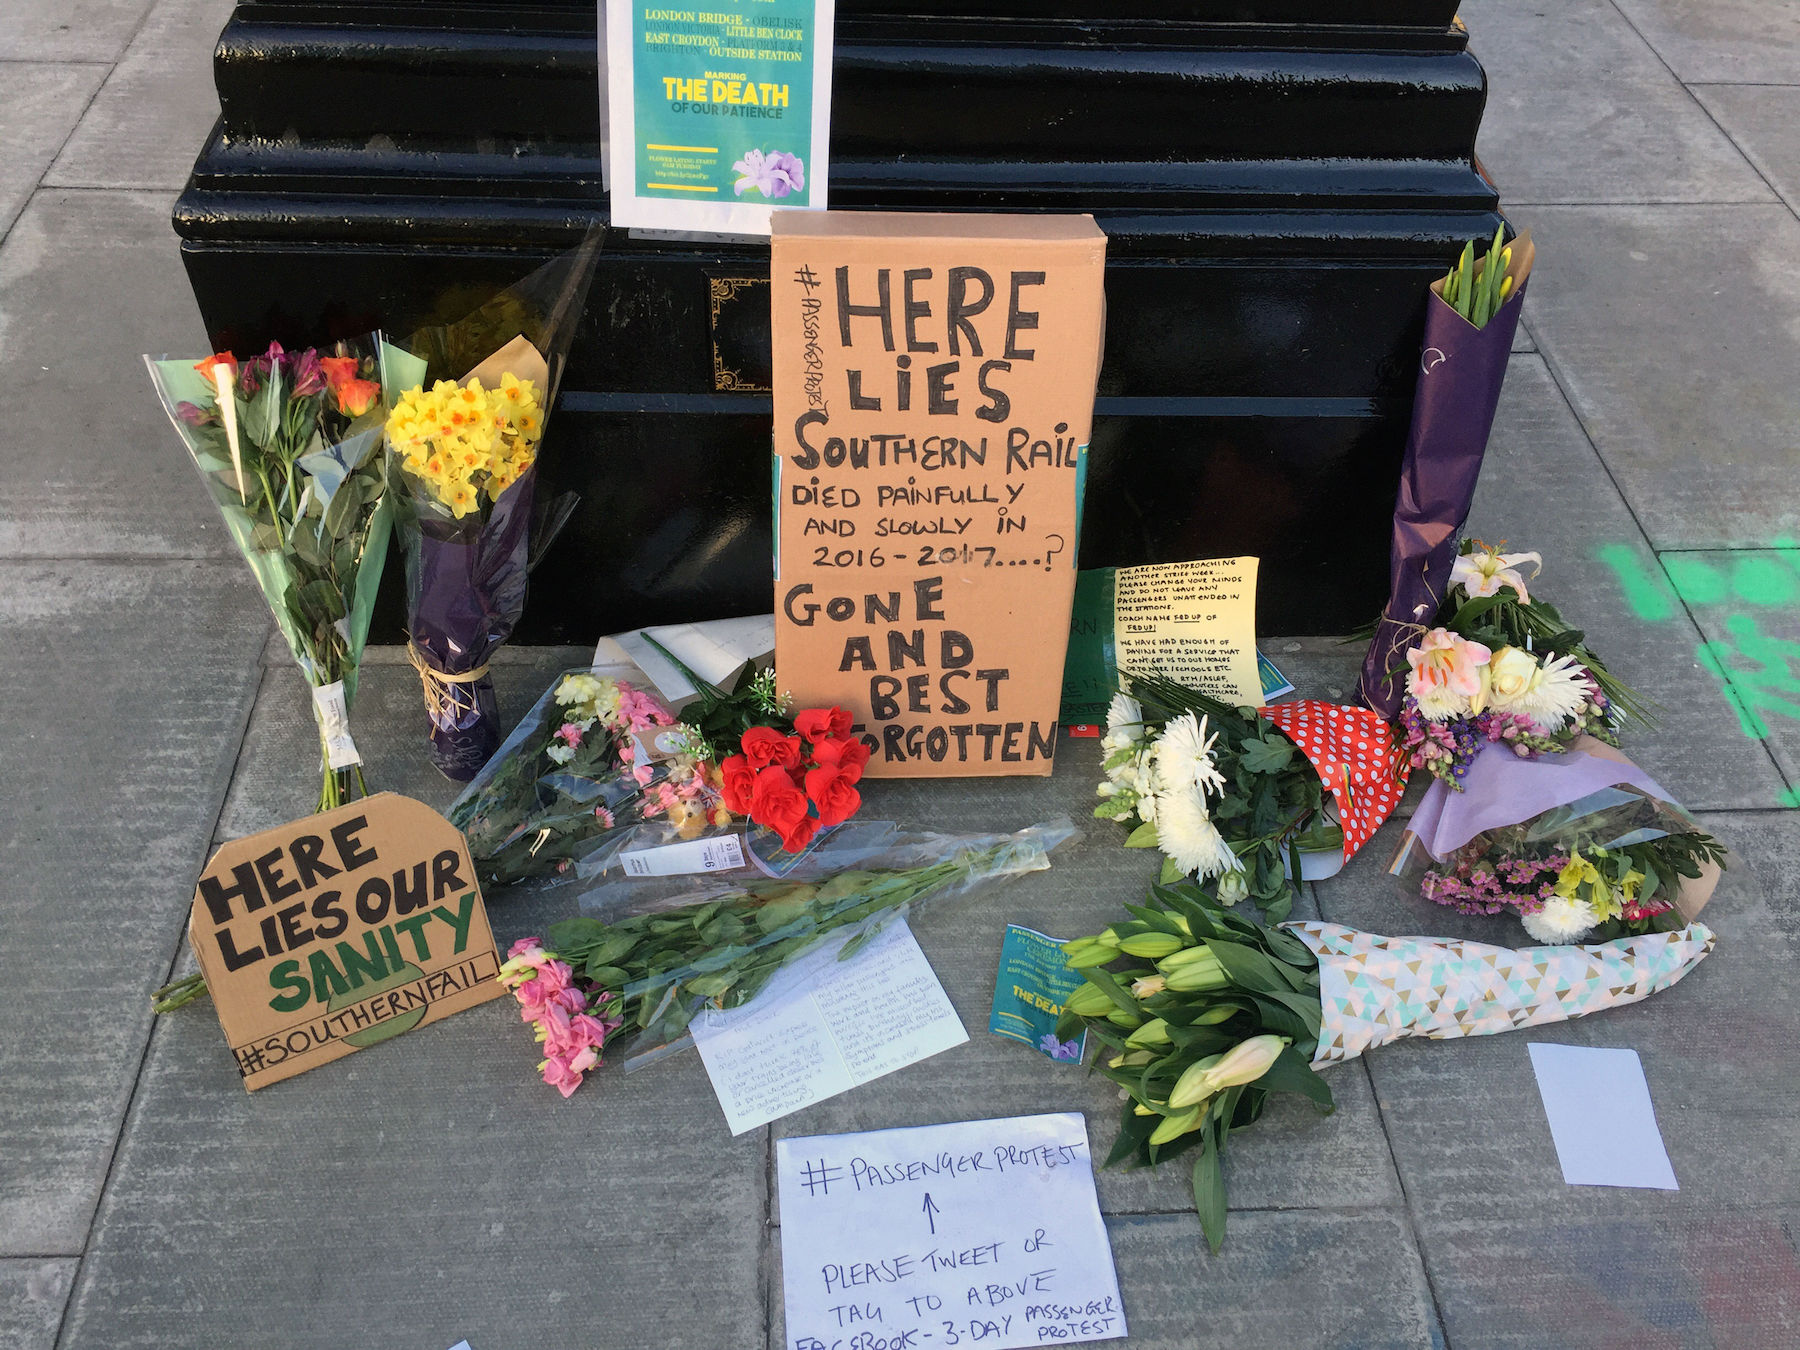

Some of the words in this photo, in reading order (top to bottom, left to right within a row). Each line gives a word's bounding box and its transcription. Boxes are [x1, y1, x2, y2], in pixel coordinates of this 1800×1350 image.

[645, 9, 695, 22] LONDON
[698, 12, 743, 26] BRIDGE
[752, 15, 803, 29] OBELISK
[645, 32, 671, 44] EAST
[672, 33, 720, 47] CROYDON
[726, 25, 755, 38] LITTLE
[756, 27, 774, 39] BEN
[775, 28, 803, 41] CLOCK
[708, 47, 756, 60] OUTSIDE
[758, 49, 802, 62] STATION
[704, 71, 747, 82] MARKING
[662, 77, 708, 102] THE
[712, 80, 789, 108] DEATH
[671, 102, 688, 114] OF
[691, 103, 719, 116] OUR
[722, 105, 783, 120] PATIENCE
[835, 266, 1046, 361] HERE
[791, 409, 988, 471] SOUTHERN
[803, 518, 856, 537] AND
[874, 516, 973, 538] SLOWLY
[1120, 573, 1160, 581] ANOTHER
[1164, 571, 1189, 579] STRIKE
[1173, 559, 1236, 571] APPROACHING
[1119, 581, 1148, 589] PLEASE
[1198, 584, 1219, 592] ANY
[783, 576, 946, 627] GONE
[1117, 595, 1167, 605] PASSENGERS
[1118, 615, 1144, 623] COACH
[838, 628, 974, 672] AND
[1126, 648, 1156, 656] PAYING
[870, 668, 1010, 721] BEST
[198, 815, 379, 925] HERE
[214, 890, 349, 972] LIES
[355, 850, 468, 925] OUR
[1011, 928, 1057, 949] PASSENGER
[268, 891, 476, 1013] SANITY
[1013, 985, 1034, 1005] THE
[1035, 997, 1066, 1015] DEAT
[240, 961, 495, 1073] #SOUTHERNFAIL
[822, 1254, 915, 1295] PLEASE
[920, 1241, 1005, 1273] TWEET
[1023, 1228, 1053, 1254] OR
[828, 1302, 883, 1328] TAG
[905, 1294, 942, 1318] TO
[967, 1268, 1057, 1308] ABOVE
[1024, 1296, 1116, 1323] PASSENGER
[1037, 1317, 1116, 1342] PROTEST
